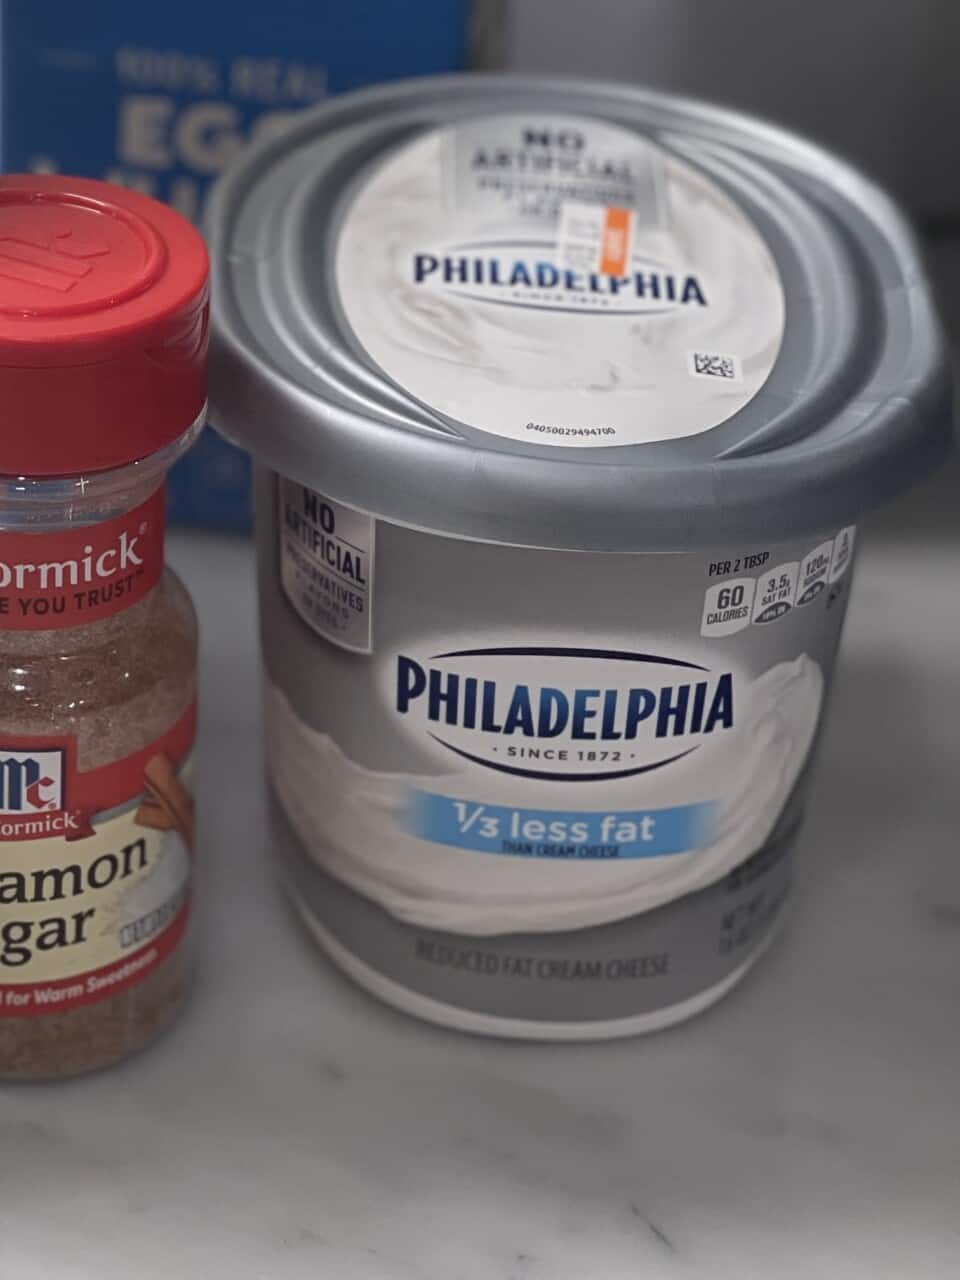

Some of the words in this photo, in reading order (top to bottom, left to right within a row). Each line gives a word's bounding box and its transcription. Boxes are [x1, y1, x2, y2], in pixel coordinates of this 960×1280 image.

[709, 560, 731, 577] PER
[734, 560, 741, 572] 2
[744, 551, 770, 569] TBSP
[18, 595, 67, 616] YOU
[74, 577, 135, 611] TRUST
[717, 585, 745, 609] 60
[706, 606, 749, 624] CALORIES
[396, 654, 734, 741] PHILADELPHIA
[507, 746, 568, 762] SINCE
[576, 748, 622, 762] 1872
[511, 811, 588, 843] less
[600, 813, 656, 843] fat
[5, 990, 31, 1006] for
[33, 984, 83, 1005] Warm
